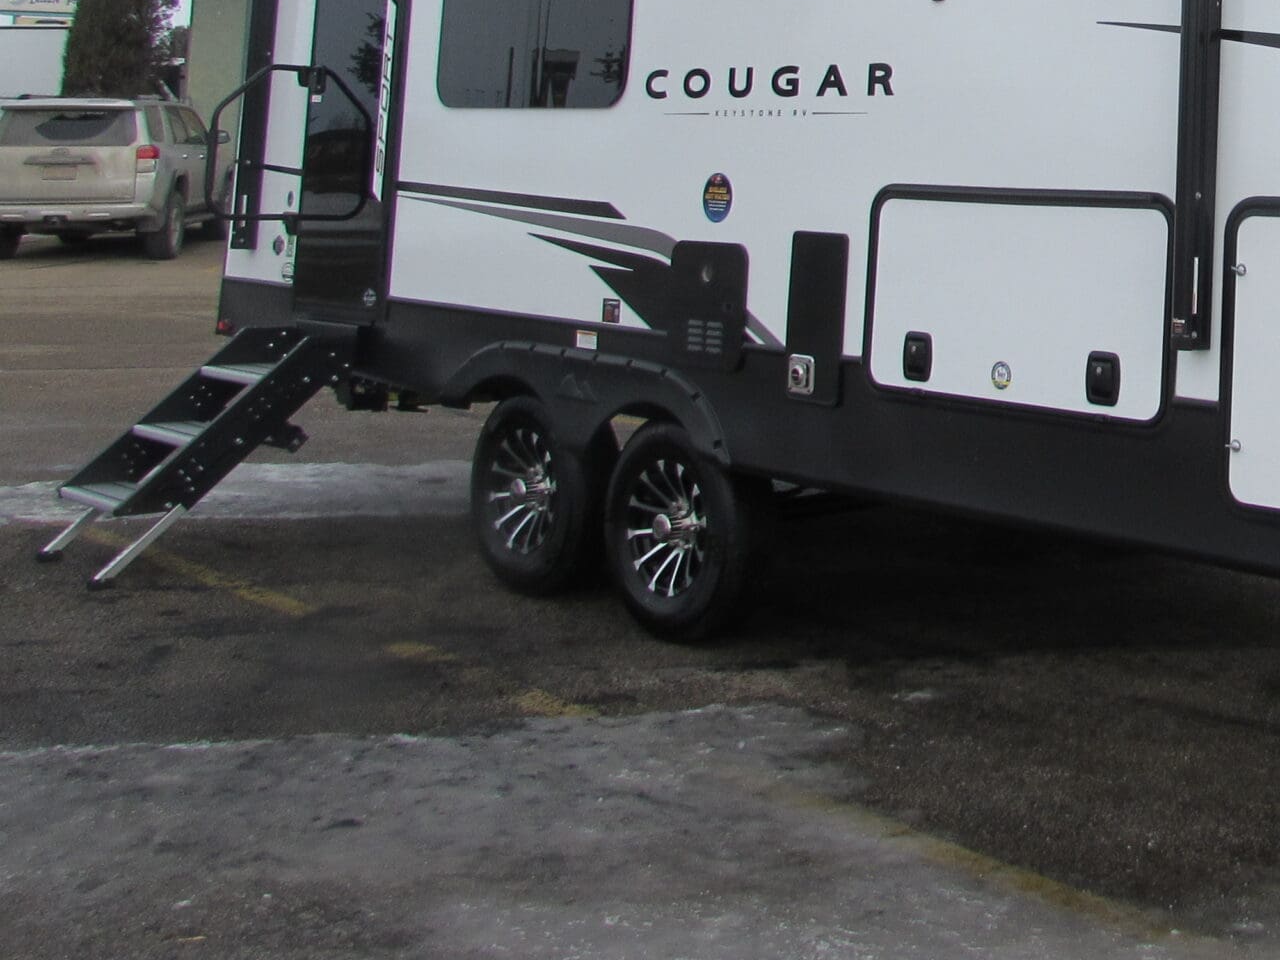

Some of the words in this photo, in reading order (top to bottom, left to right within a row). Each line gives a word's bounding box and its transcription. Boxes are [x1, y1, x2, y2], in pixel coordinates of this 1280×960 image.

[645, 63, 895, 99] COUGAR
[715, 109, 782, 117] KEYSTONE
[793, 109, 807, 117] RV
